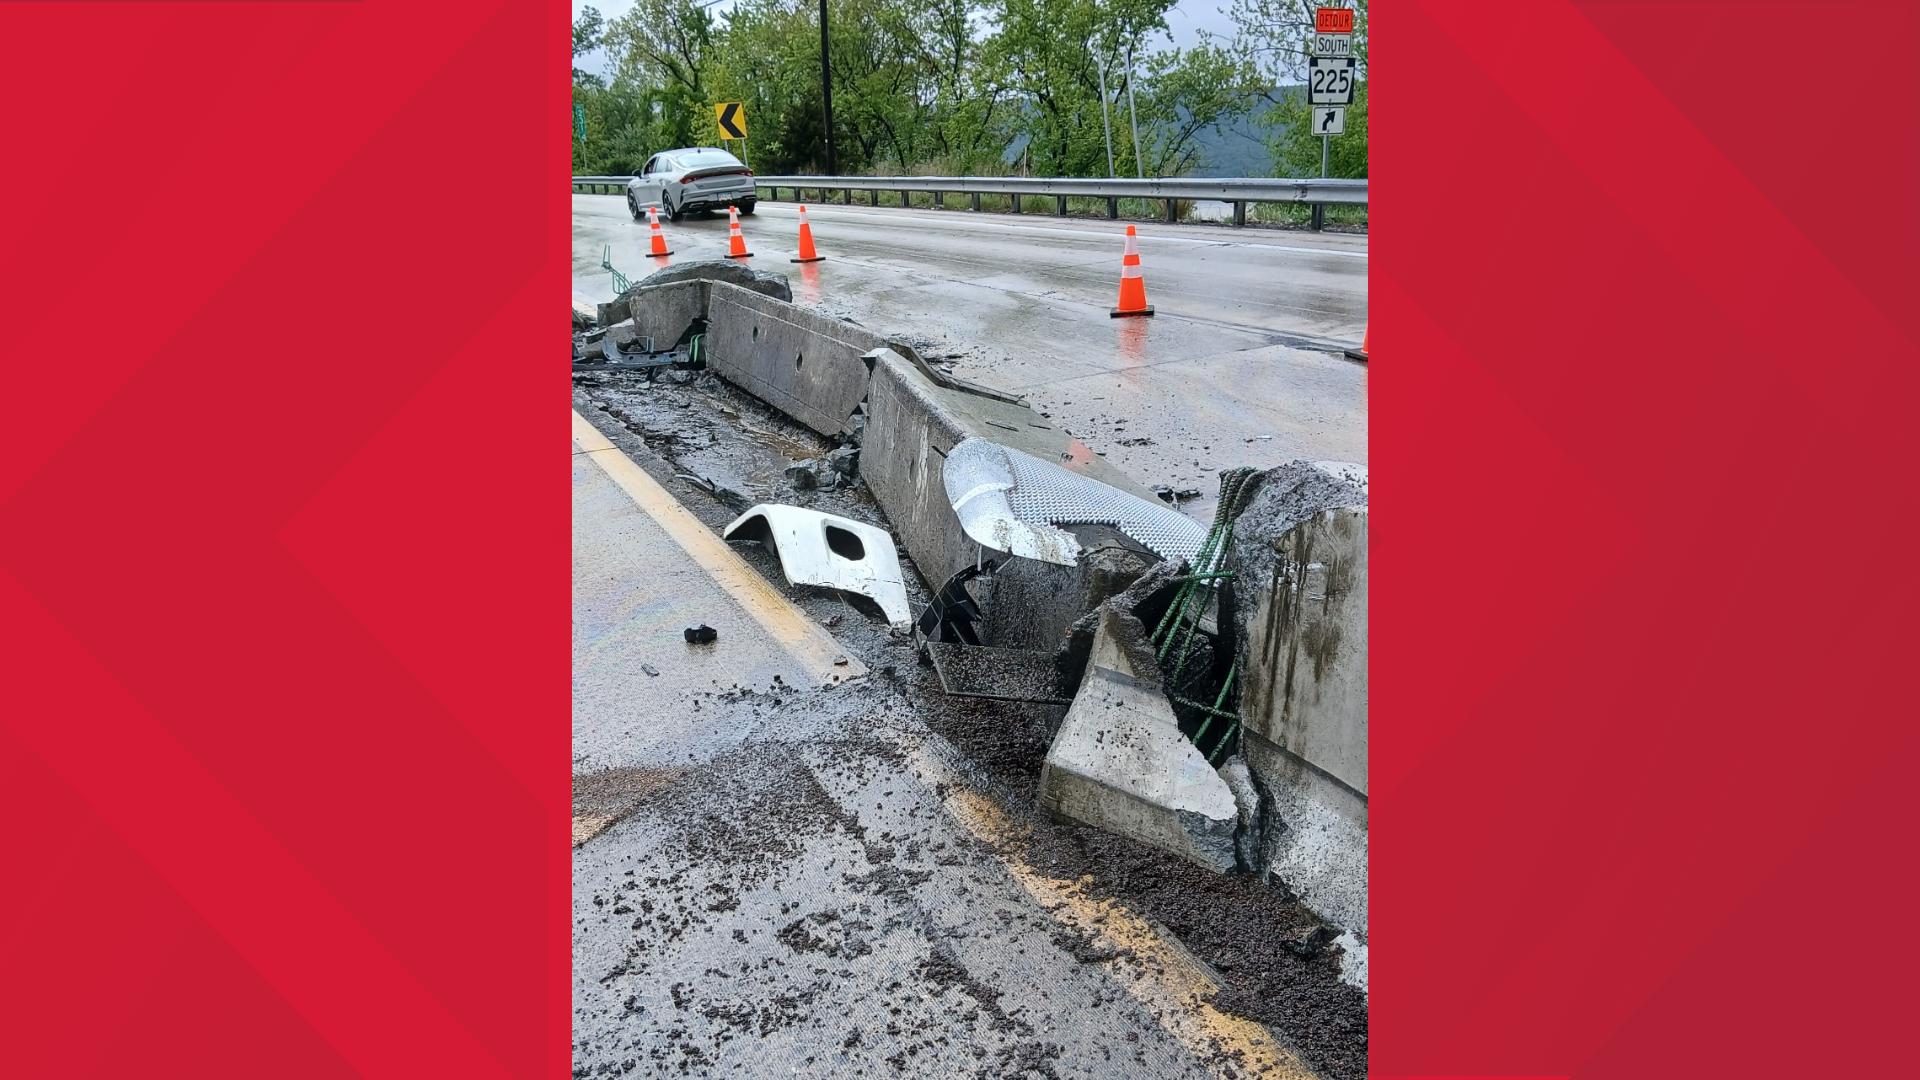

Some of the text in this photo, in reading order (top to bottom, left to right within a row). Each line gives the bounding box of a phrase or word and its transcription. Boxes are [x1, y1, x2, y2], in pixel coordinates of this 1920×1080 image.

[1319, 15, 1350, 27] DETOUR
[1317, 37, 1348, 52] SOUTH
[1313, 69, 1349, 94] 225
